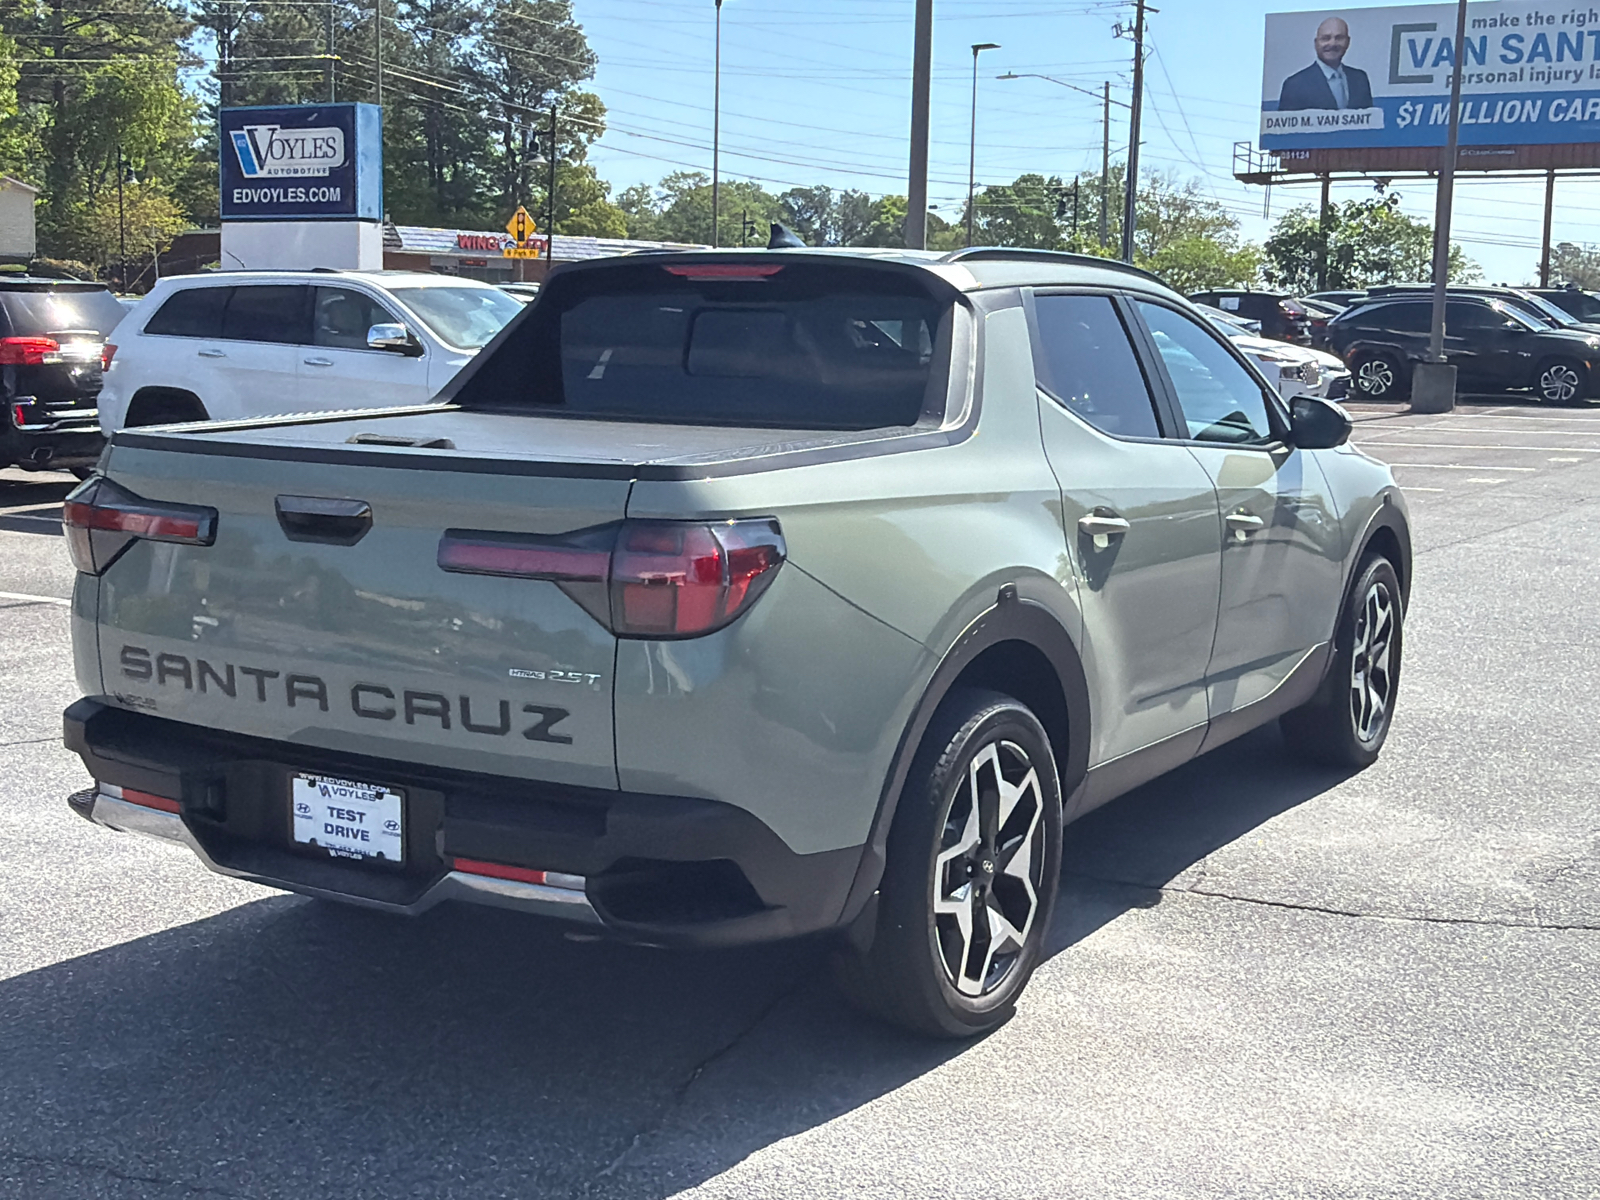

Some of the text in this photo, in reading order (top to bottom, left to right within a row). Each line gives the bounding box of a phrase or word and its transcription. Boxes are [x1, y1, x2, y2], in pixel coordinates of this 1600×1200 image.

[1471, 8, 1600, 29] make the righ
[1407, 30, 1600, 69] VAN SANT
[1529, 65, 1584, 85] injury
[1266, 113, 1372, 129] DAVID M. VAN SANT
[1396, 97, 1600, 129] $1 MILLION CAR
[267, 166, 328, 175] AUTOMOTIVE
[233, 187, 341, 203] EDVOYLES.COM
[509, 669, 545, 680] HTRAC
[120, 645, 574, 745] SANTA CRUZ
[331, 785, 377, 802] VOYLES
[327, 806, 367, 824] TEST
[324, 823, 370, 842] DRIVE
